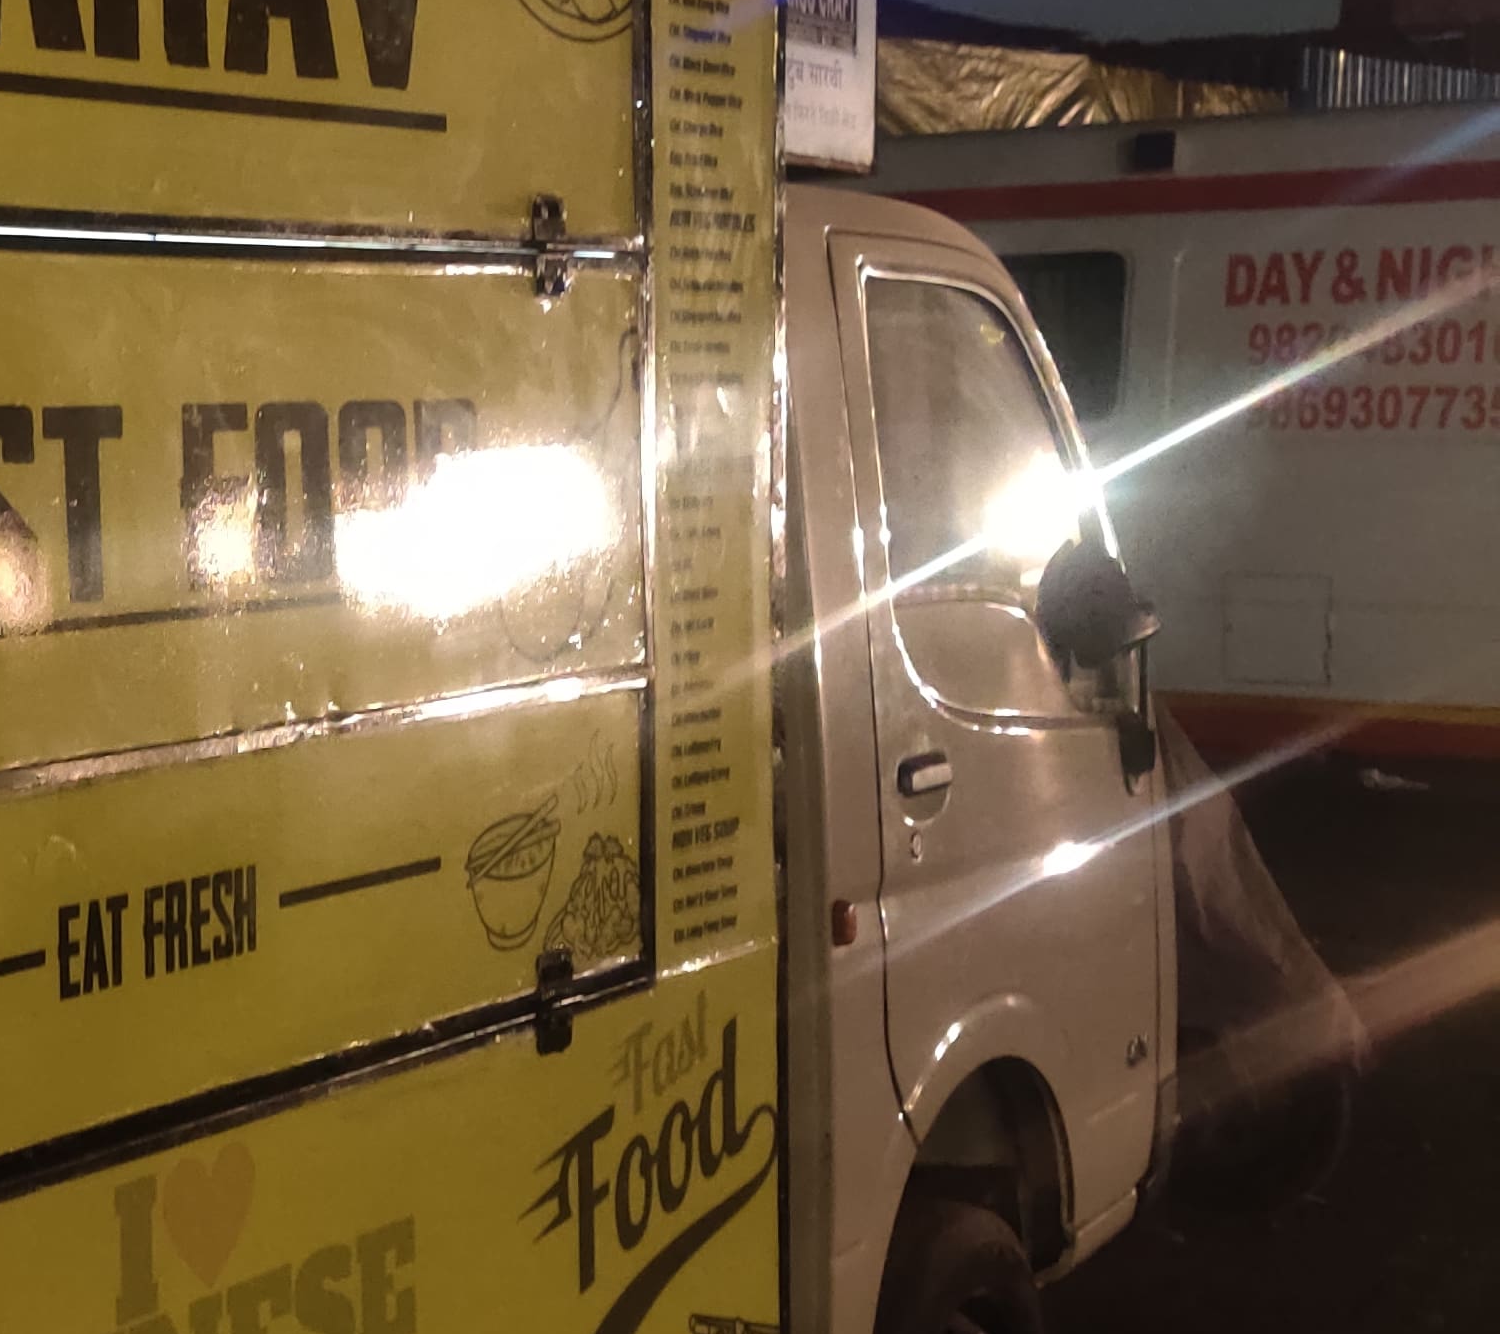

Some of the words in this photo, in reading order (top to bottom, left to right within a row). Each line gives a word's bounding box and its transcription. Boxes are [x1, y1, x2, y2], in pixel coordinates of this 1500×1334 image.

[1225, 250, 1325, 307] DAY
[1332, 248, 1366, 305] &
[58, 892, 129, 1001] EAT
[142, 865, 256, 978] FRESH
[611, 990, 710, 1116] Fast
[518, 1014, 758, 1294] Food
[113, 1174, 161, 1327] I
